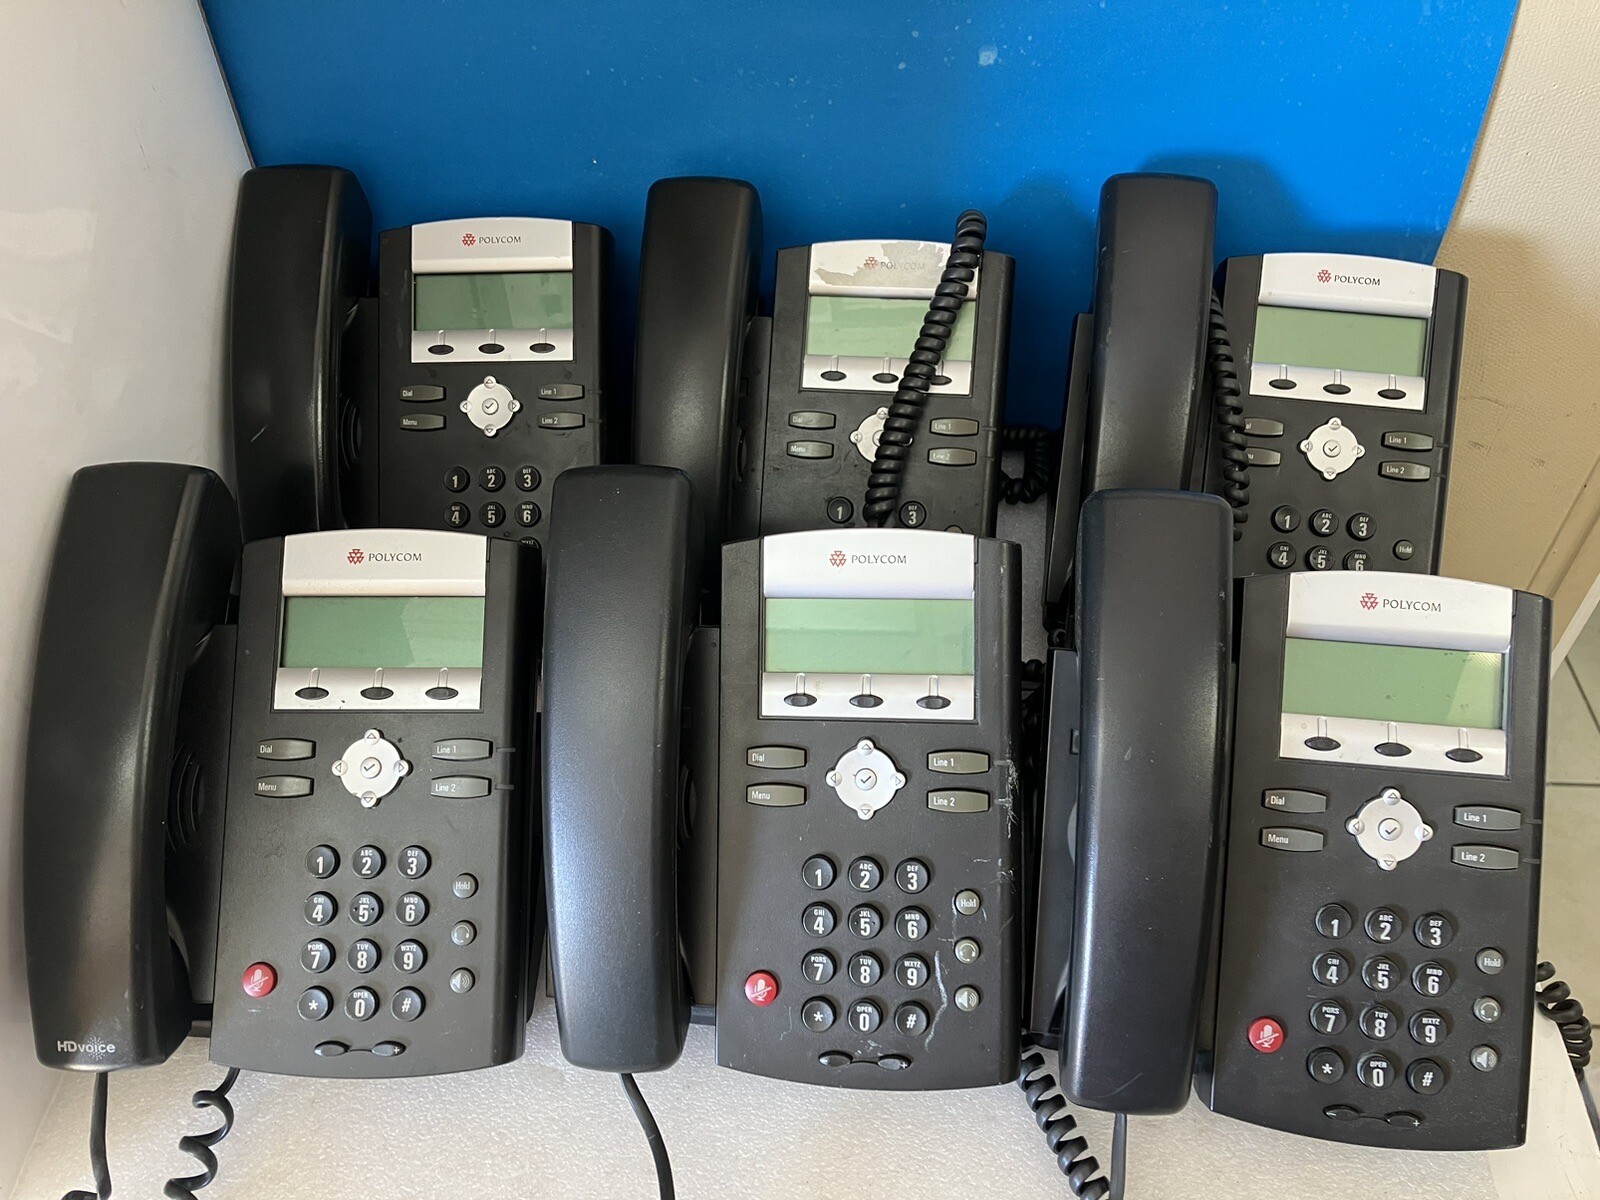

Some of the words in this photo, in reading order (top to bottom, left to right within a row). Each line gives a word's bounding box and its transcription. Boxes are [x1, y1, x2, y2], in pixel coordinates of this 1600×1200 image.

[479, 236, 521, 244] POLYCOM
[1334, 275, 1381, 286] POLYCOM
[453, 475, 458, 488] 1
[488, 474, 495, 487] 2
[524, 474, 531, 487] 3
[452, 511, 460, 524] 4
[487, 511, 495, 523] 5
[523, 510, 531, 522] 6
[837, 506, 843, 520] 1
[908, 511, 917, 525] 3
[1284, 515, 1290, 528] 1
[1321, 519, 1330, 532] 2
[1359, 523, 1367, 536] 3
[368, 553, 422, 562] POLYCOM
[851, 555, 907, 564] POLYCOM
[1278, 552, 1288, 565] 4
[1317, 556, 1326, 568] 5
[1356, 560, 1364, 571] 6
[1383, 599, 1442, 612] POLYCOM
[260, 745, 272, 753] Dial
[436, 745, 451, 753] Line
[453, 746, 456, 754] 1
[933, 758, 948, 766] Line
[258, 783, 276, 791] Menu
[435, 783, 449, 792] Line
[450, 784, 456, 792] 2
[752, 791, 770, 799] Menu
[933, 797, 948, 805] Line
[949, 798, 955, 806] 2
[1271, 796, 1285, 805] Dial
[1464, 813, 1480, 822] Line
[1481, 814, 1487, 823] 1
[1268, 834, 1288, 844] Menu
[1461, 852, 1478, 862] Line
[1479, 853, 1485, 862] 2
[317, 856, 324, 873] 1
[362, 857, 371, 874] 2
[407, 858, 417, 875] 3
[815, 869, 822, 886] 1
[860, 871, 870, 888] 2
[907, 872, 917, 890] 3
[960, 899, 977, 907] Hold
[312, 905, 323, 922] 4
[358, 905, 368, 922] 5
[405, 905, 415, 922] 6
[813, 917, 824, 934] 4
[860, 918, 870, 936] 5
[907, 921, 918, 938] 6
[1331, 919, 1339, 937] 1
[1380, 923, 1391, 941] 2
[1430, 928, 1441, 946] 3
[311, 951, 321, 969] 7
[357, 951, 367, 969] 8
[403, 952, 413, 970] 9
[1484, 958, 1501, 967] Hold
[814, 964, 824, 981] 7
[860, 966, 870, 983] 8
[907, 968, 917, 986] 9
[1326, 967, 1339, 984] 4
[1377, 971, 1389, 989] 5
[1427, 976, 1439, 994] 6
[355, 1000, 365, 1017] 0
[401, 998, 411, 1013] #
[859, 1014, 870, 1031] 0
[906, 1014, 916, 1029] #
[1325, 1015, 1336, 1032] 7
[1374, 1019, 1385, 1037] 8
[1425, 1025, 1436, 1043] 9
[1373, 1069, 1384, 1087] 0
[1422, 1072, 1434, 1086] #
